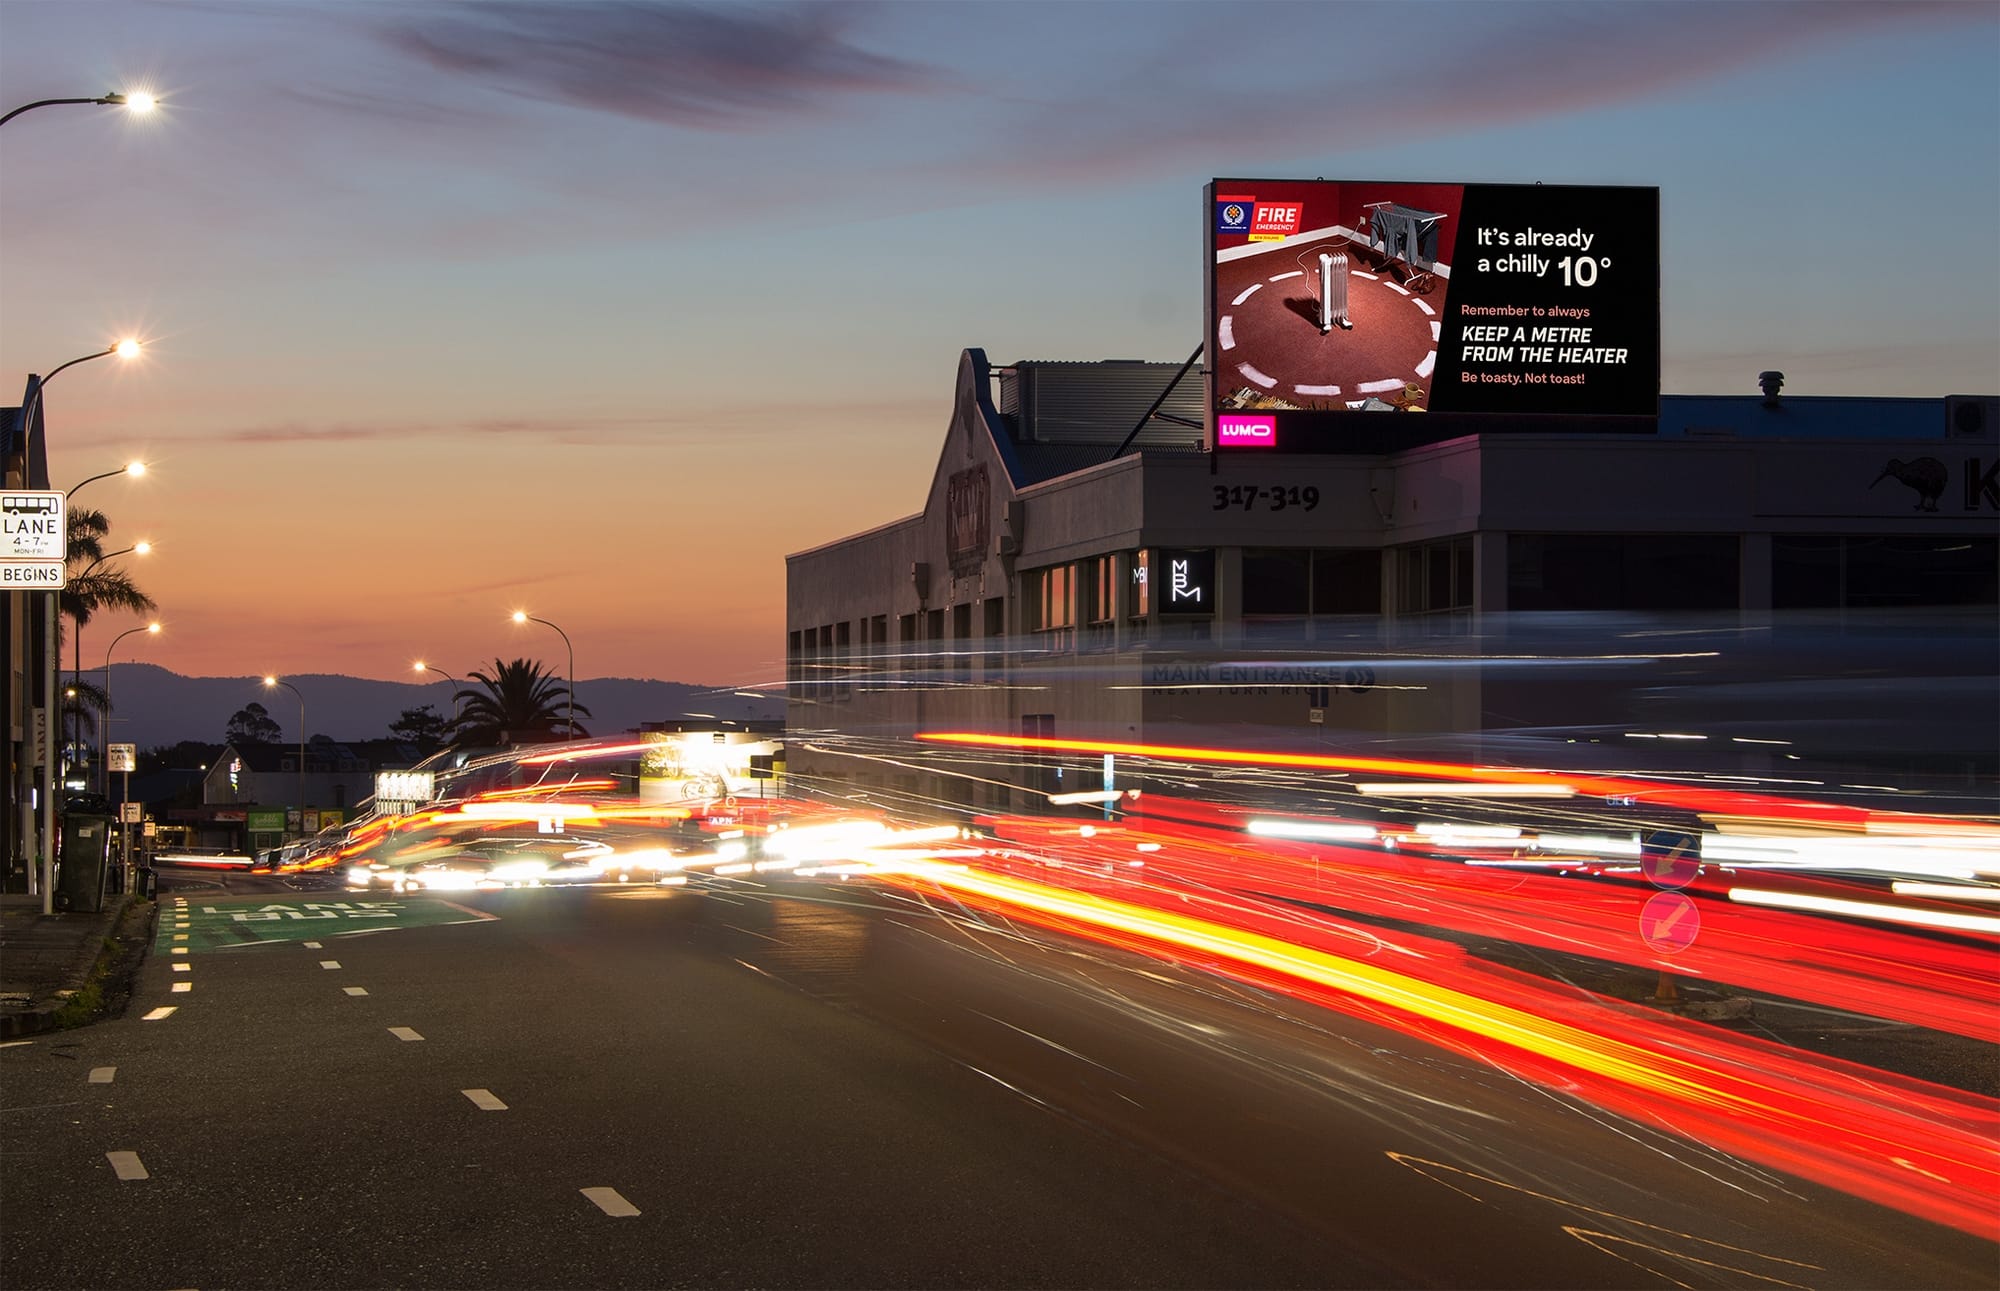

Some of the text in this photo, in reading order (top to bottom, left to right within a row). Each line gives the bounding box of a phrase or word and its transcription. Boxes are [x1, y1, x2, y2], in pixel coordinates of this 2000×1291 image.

[1257, 208, 1297, 223] FIRE
[1478, 227, 1594, 251] It’s already
[1477, 258, 1490, 273] a
[1495, 253, 1550, 277] chilly
[1461, 304, 1590, 319] Remember to always
[1462, 326, 1592, 343] KEEP A METRE
[1462, 346, 1628, 364] FROM THE HEATER
[1461, 371, 1585, 385] Be toasty. Not toast!
[1222, 424, 1271, 436] LUMO
[1213, 485, 1320, 512] 317-319
[4, 519, 57, 534] LANE
[4, 568, 58, 581] BEGINS
[1152, 665, 1341, 681] MAIN ENTRANCE
[202, 902, 407, 914] LANE
[232, 909, 399, 921] BUS
